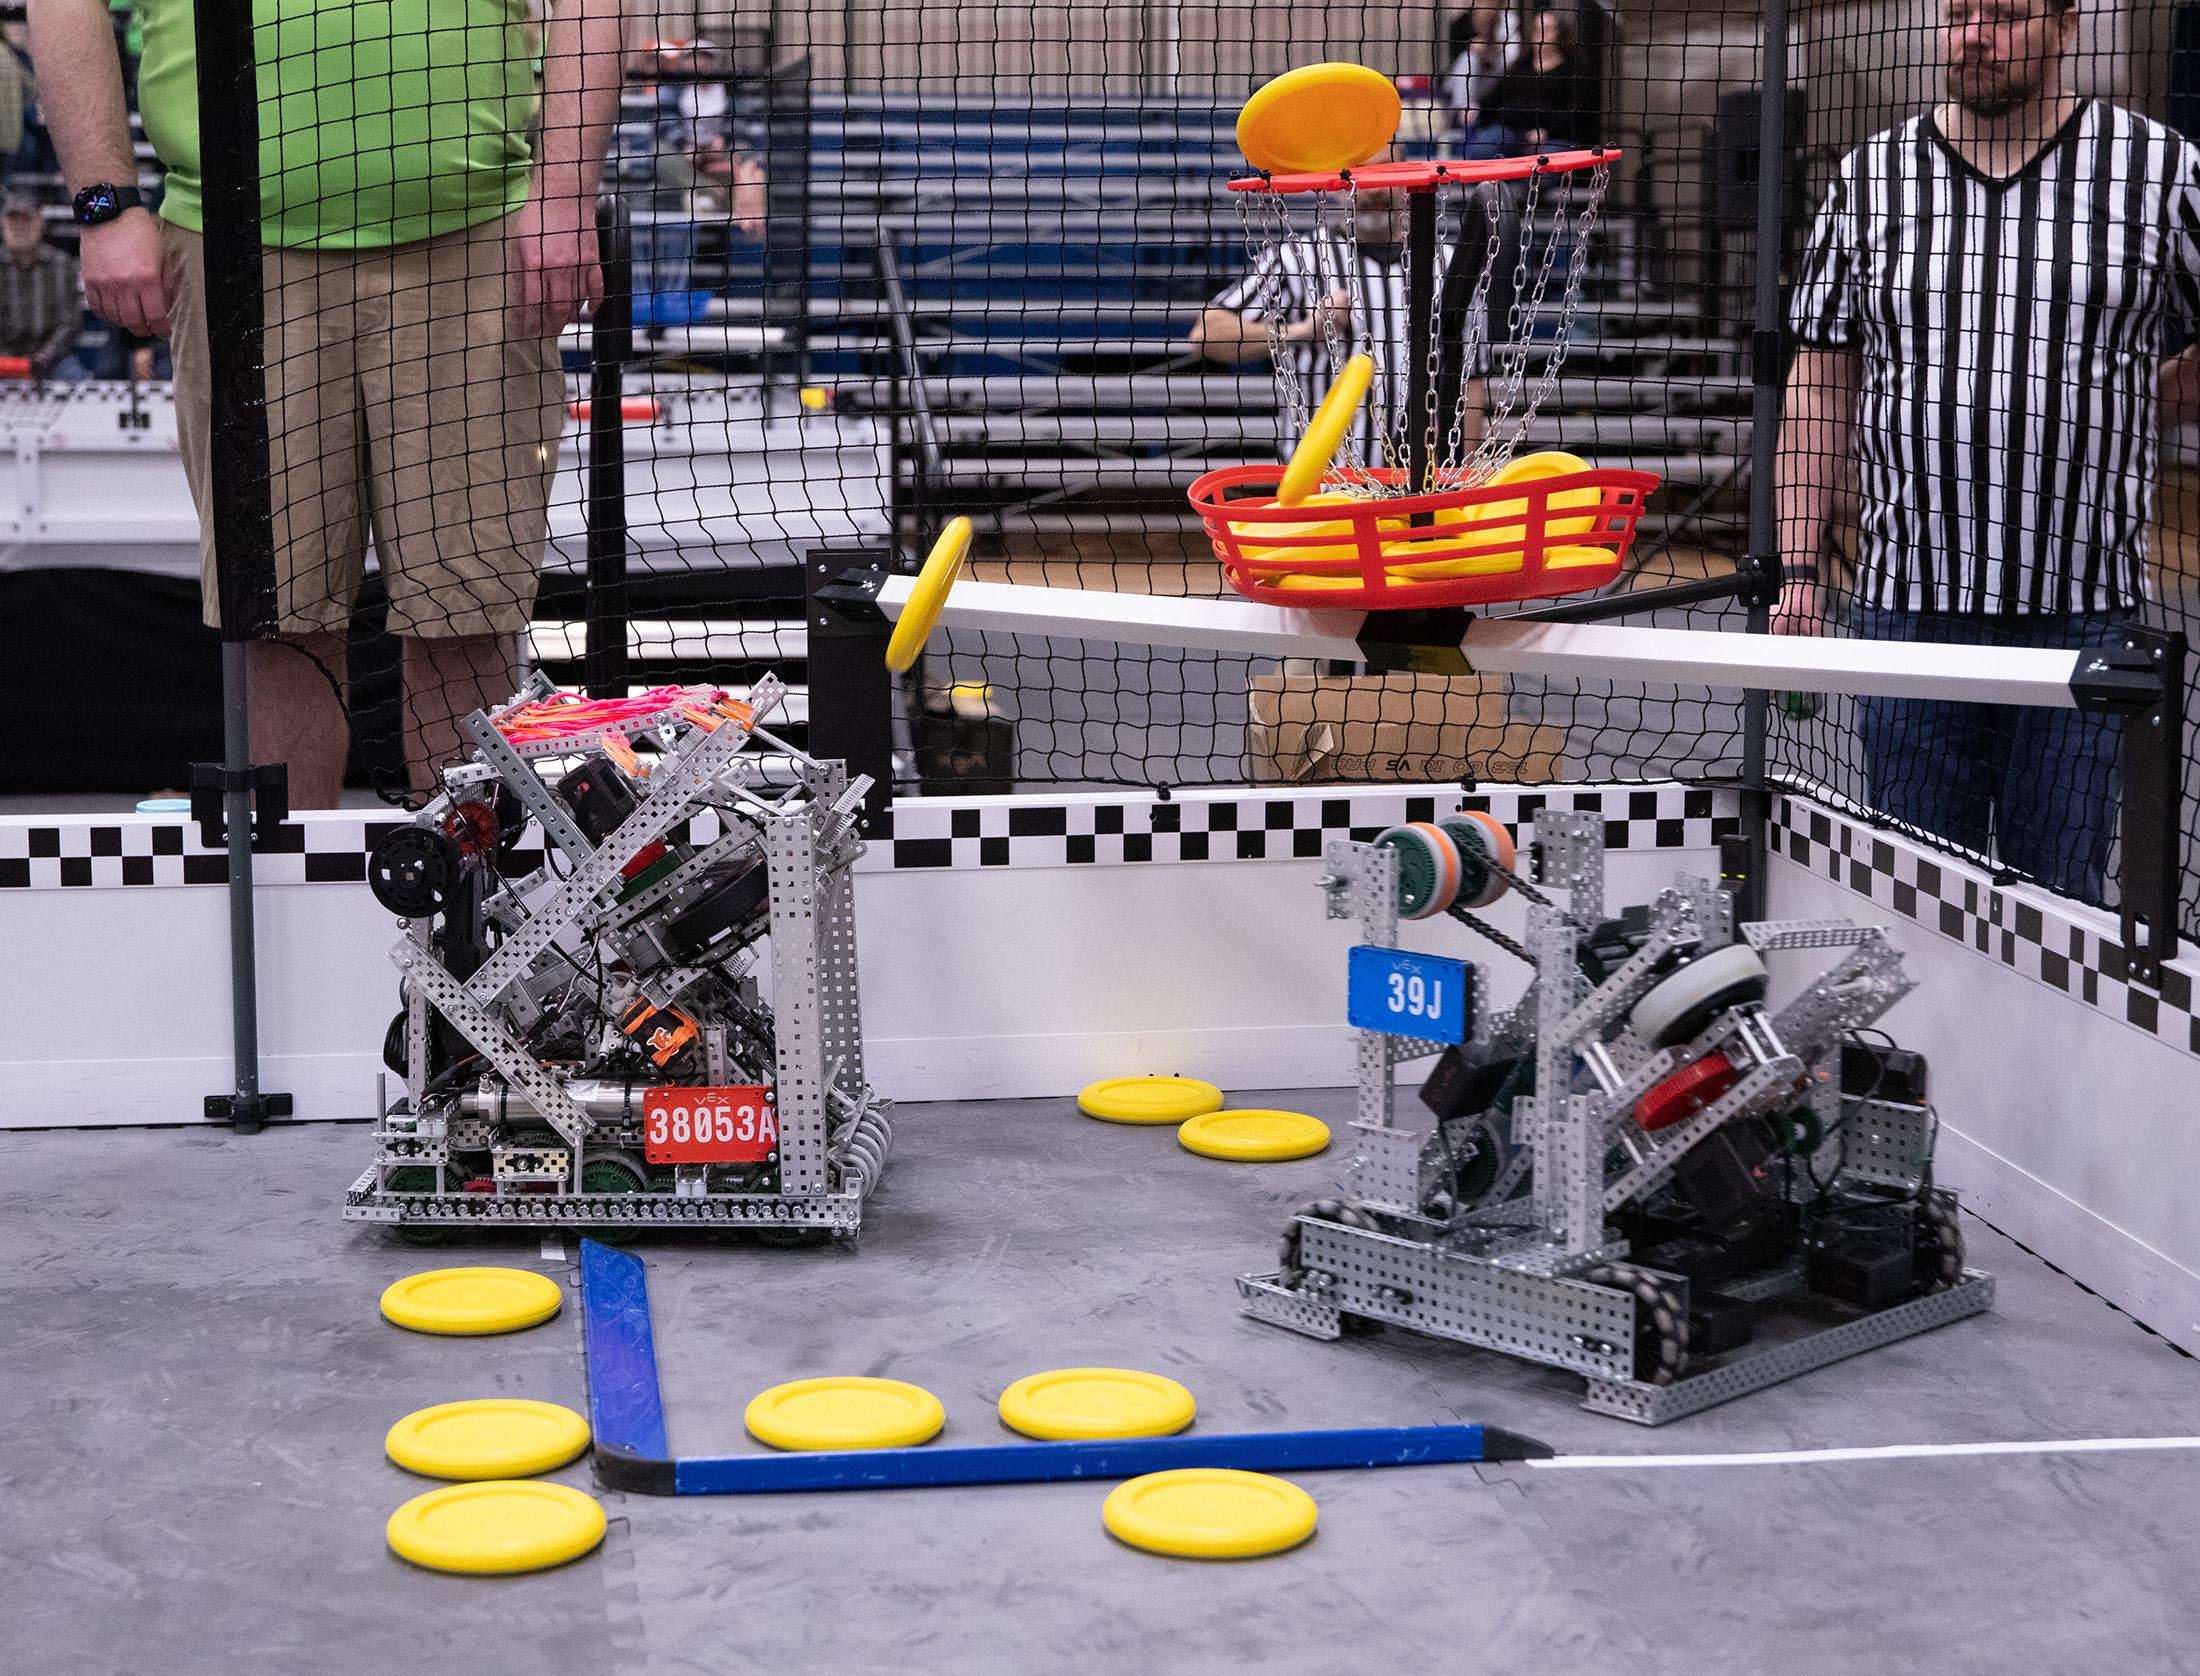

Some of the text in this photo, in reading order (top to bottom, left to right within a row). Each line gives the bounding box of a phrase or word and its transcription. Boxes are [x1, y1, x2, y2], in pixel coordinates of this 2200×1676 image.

[1392, 959, 1422, 975] VEX
[1388, 973, 1442, 1020] 39J
[693, 1092, 729, 1105] VEX
[649, 1105, 777, 1145] 38053A
